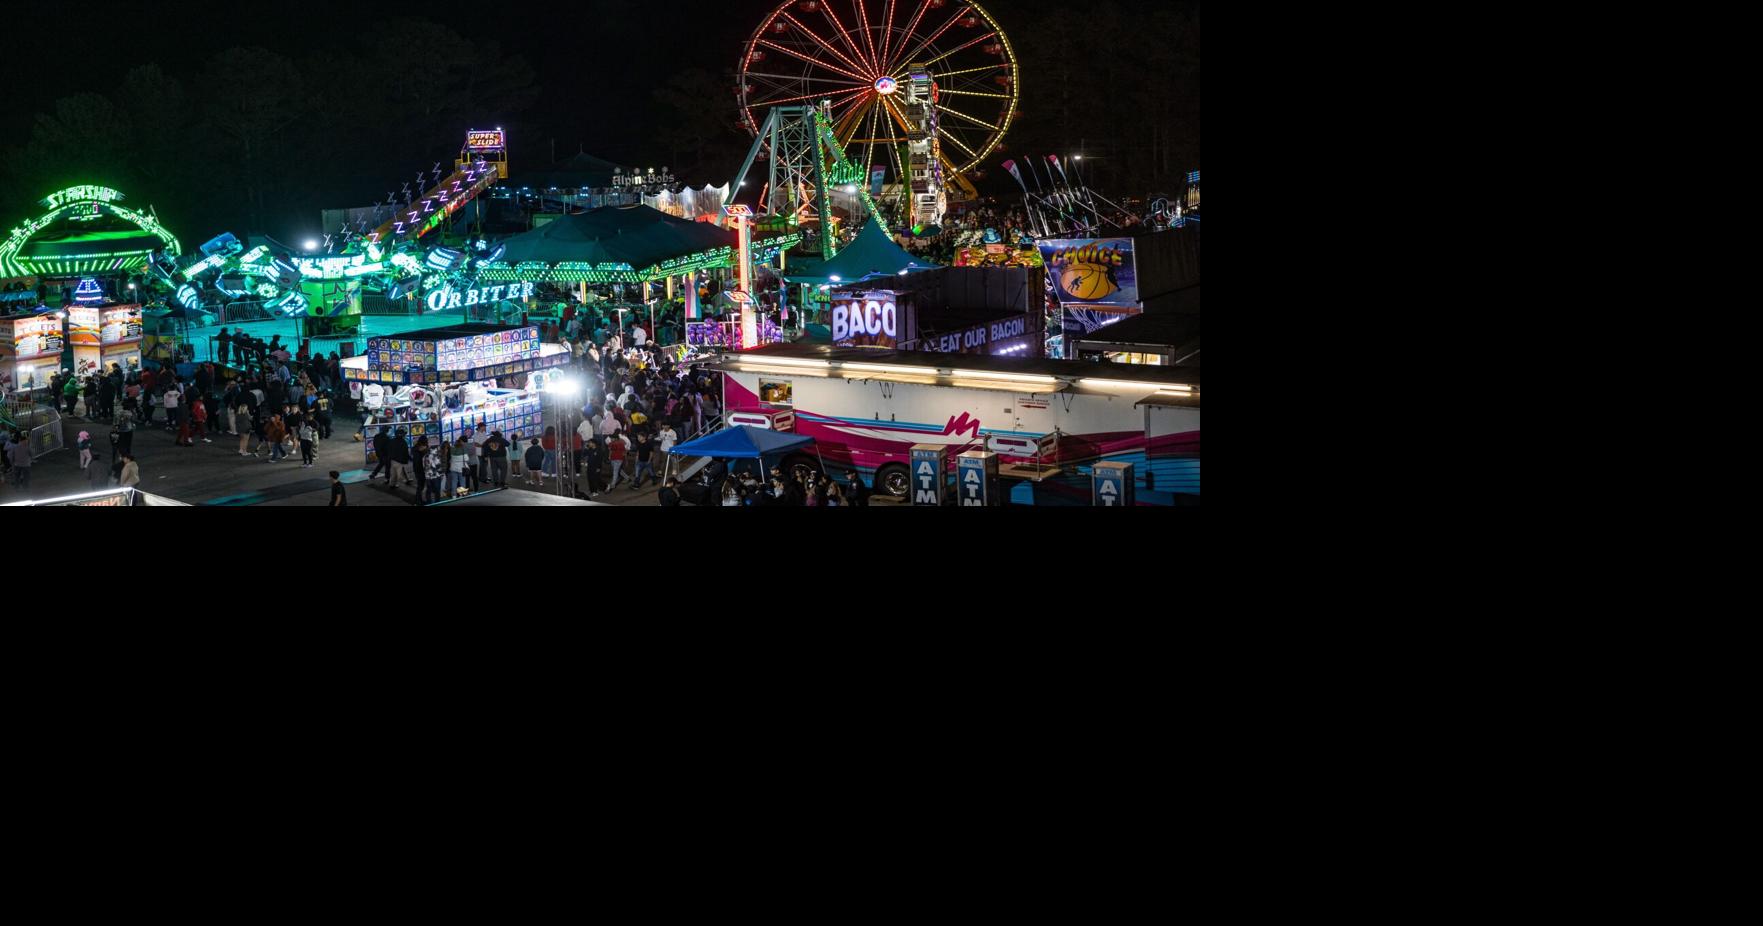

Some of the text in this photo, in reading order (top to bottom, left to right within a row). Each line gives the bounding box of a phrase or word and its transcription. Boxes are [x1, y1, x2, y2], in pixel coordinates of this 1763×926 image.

[47, 184, 118, 210] STARSHIP
[1052, 245, 1123, 267] CHOICE
[832, 300, 897, 341] BACO
[940, 333, 961, 353] EAT
[964, 327, 986, 348] OUR
[991, 317, 1025, 341] BACON
[916, 461, 937, 504] ATM
